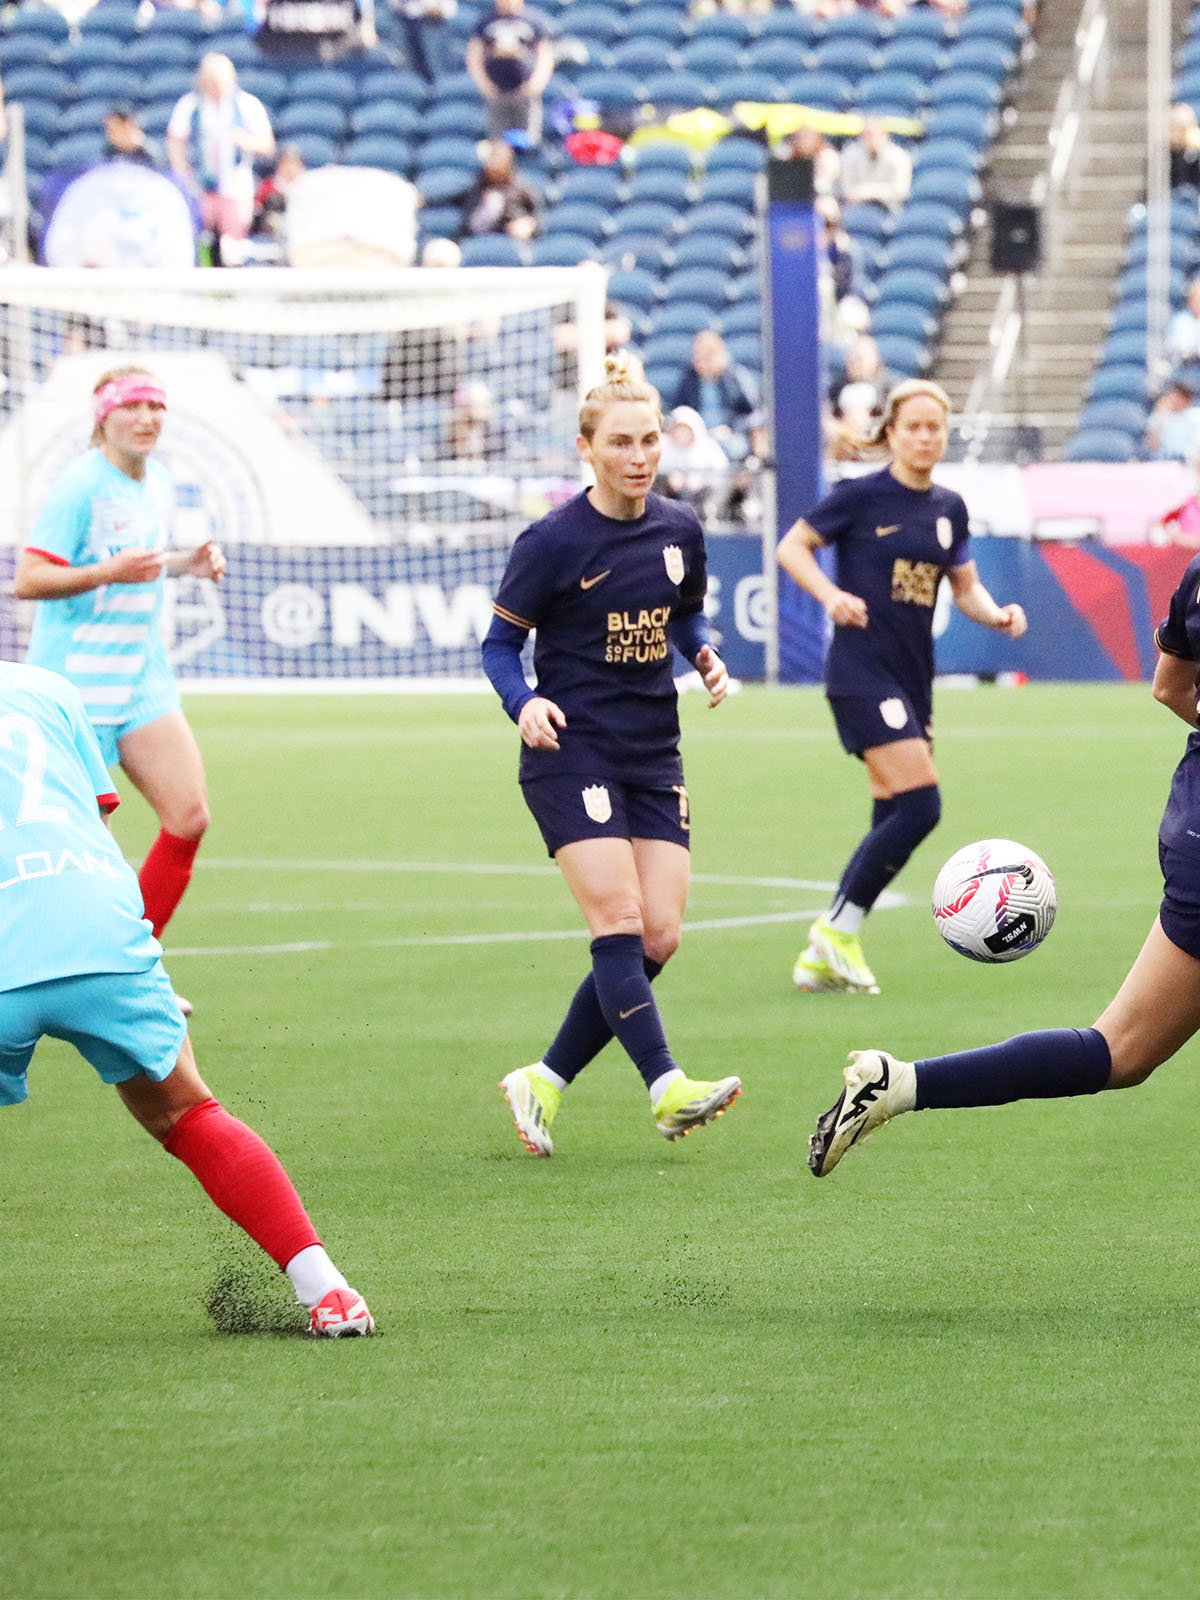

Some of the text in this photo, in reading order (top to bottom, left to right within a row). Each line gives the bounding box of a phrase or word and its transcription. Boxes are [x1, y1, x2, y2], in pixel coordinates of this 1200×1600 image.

[607, 606, 671, 632] BLACK
[606, 628, 666, 645] FUTUR
[622, 642, 668, 663] FUND
[0, 714, 71, 829] 2
